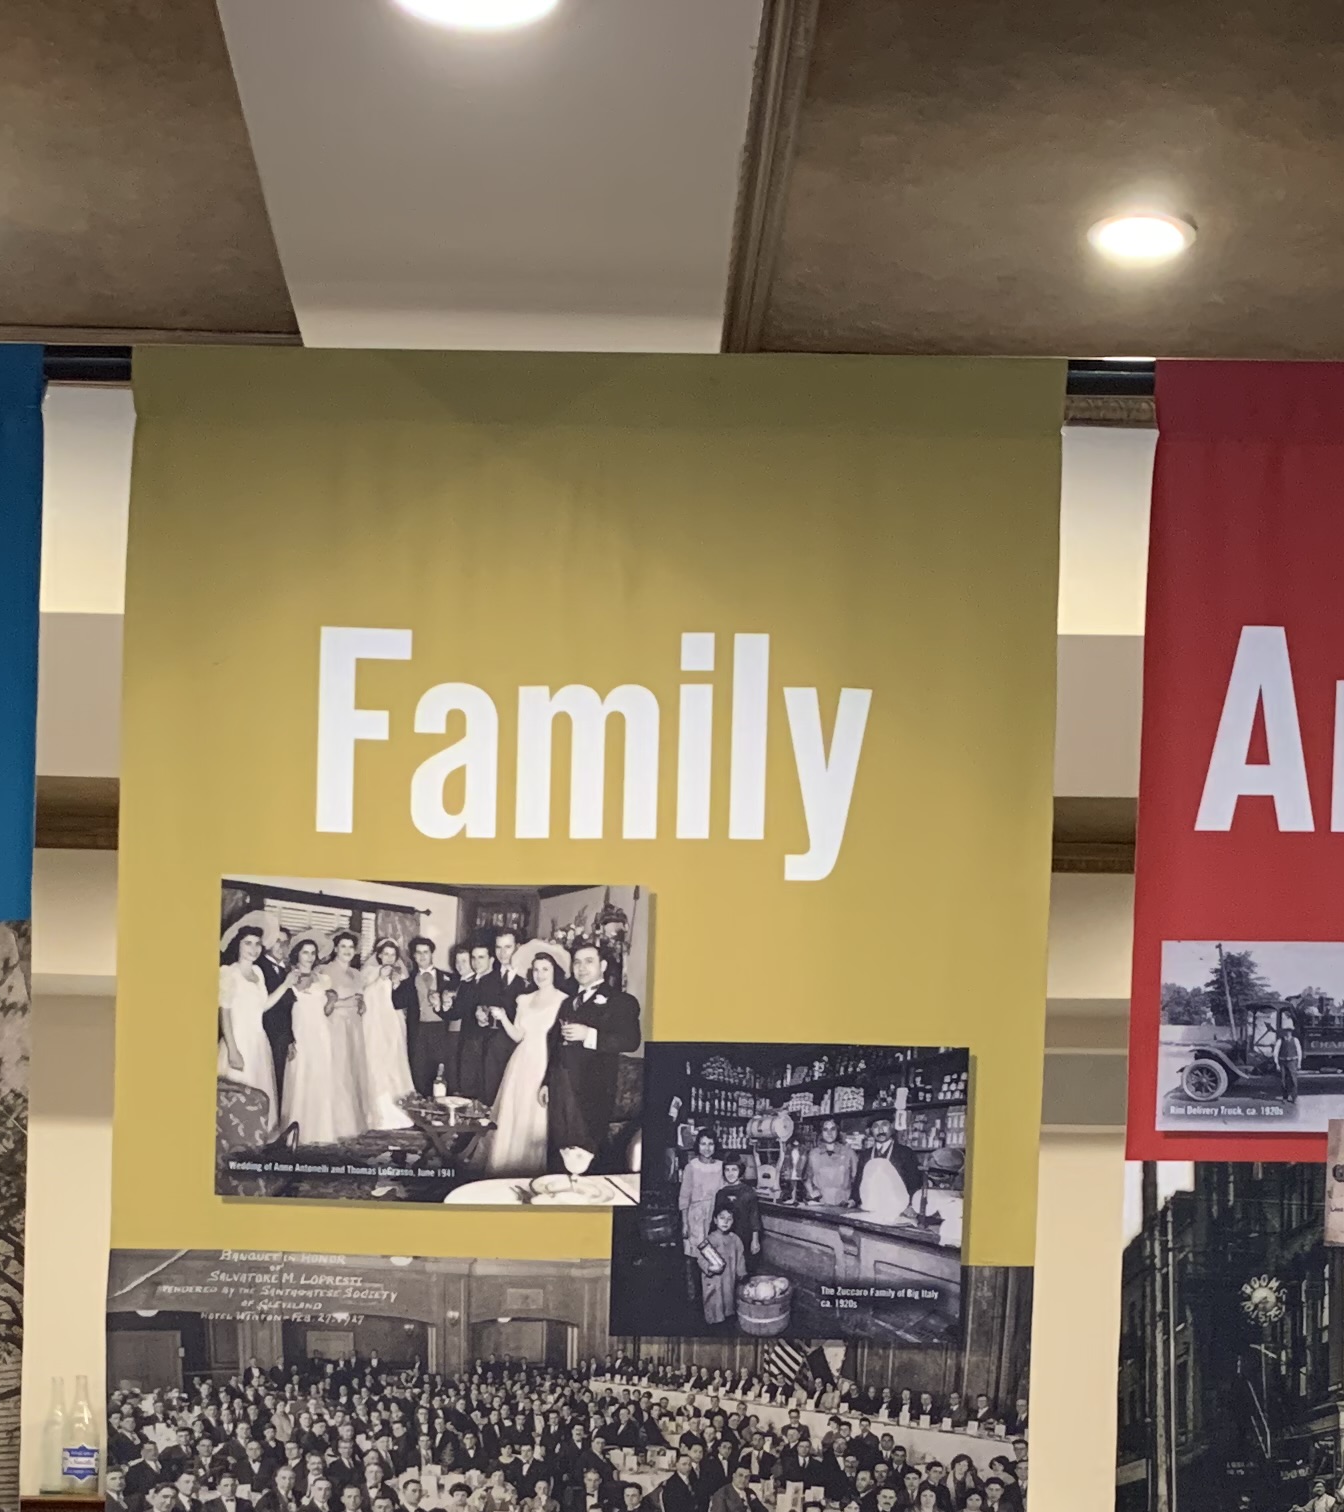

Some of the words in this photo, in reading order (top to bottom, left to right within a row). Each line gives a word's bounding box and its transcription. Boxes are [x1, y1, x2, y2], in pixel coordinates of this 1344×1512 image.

[316, 626, 872, 881] Family
[1187, 1105, 1218, 1117] Delivery
[1246, 1108, 1258, 1116] ca.
[1260, 1106, 1285, 1117] 1920s
[229, 1160, 262, 1173] Wedding
[264, 1162, 272, 1171] of
[274, 1163, 294, 1172] Anne
[295, 1163, 329, 1174] Antonelli
[331, 1165, 345, 1174] and
[347, 1165, 377, 1176] Thomas
[417, 1168, 435, 1177] June
[437, 1168, 455, 1178] 1941
[301, 1254, 346, 1266] HONOR
[207, 1270, 281, 1284] SALVATORE
[300, 1274, 363, 1287] LOPRESTI
[344, 1287, 398, 1304] SOCIETY
[821, 1286, 835, 1297] The
[836, 1286, 868, 1297] Zuccaro
[870, 1288, 896, 1300] Family
[897, 1288, 906, 1298] of
[907, 1289, 920, 1300] Big
[921, 1290, 940, 1300] Italy
[256, 1299, 323, 1311] CLEVELAND
[821, 1300, 832, 1308] ca.
[835, 1299, 858, 1309] 1920s
